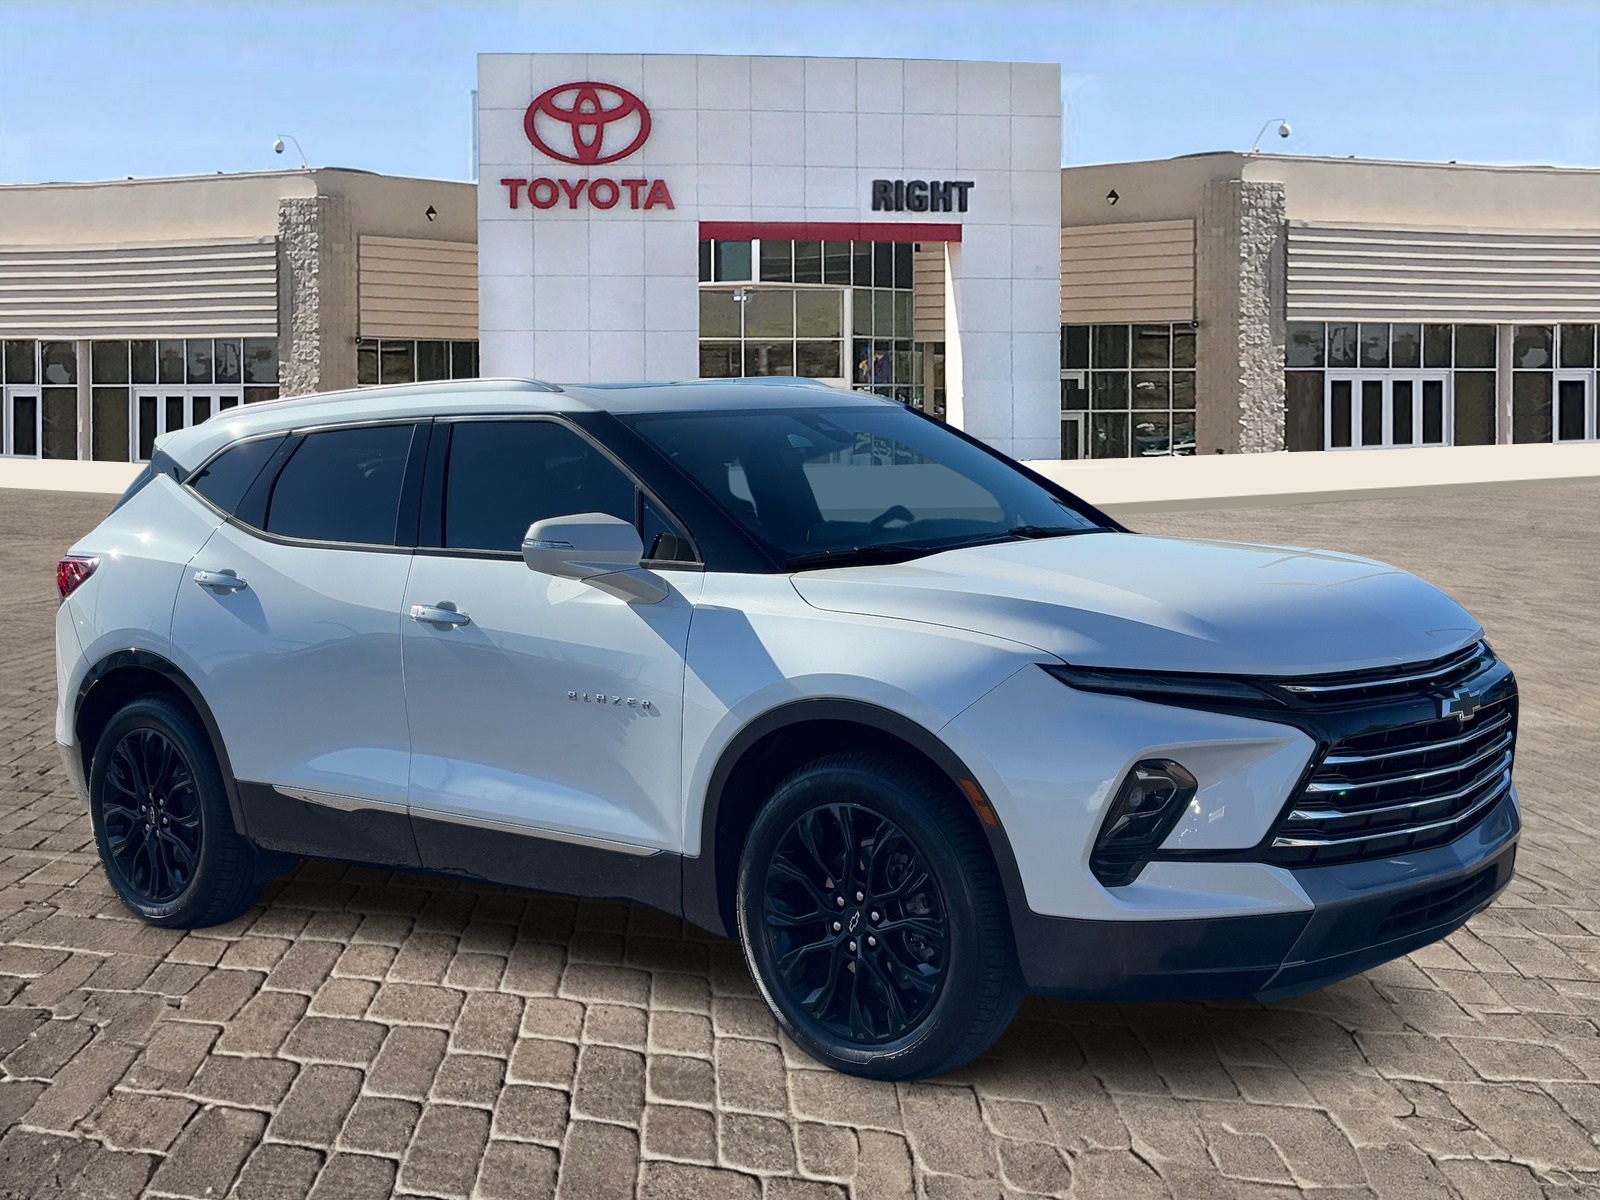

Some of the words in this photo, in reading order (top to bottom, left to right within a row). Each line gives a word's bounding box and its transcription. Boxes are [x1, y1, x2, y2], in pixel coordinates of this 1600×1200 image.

[500, 177, 676, 210] TOYOTA
[871, 179, 975, 213] RIGHT
[567, 690, 651, 710] BLAZER
